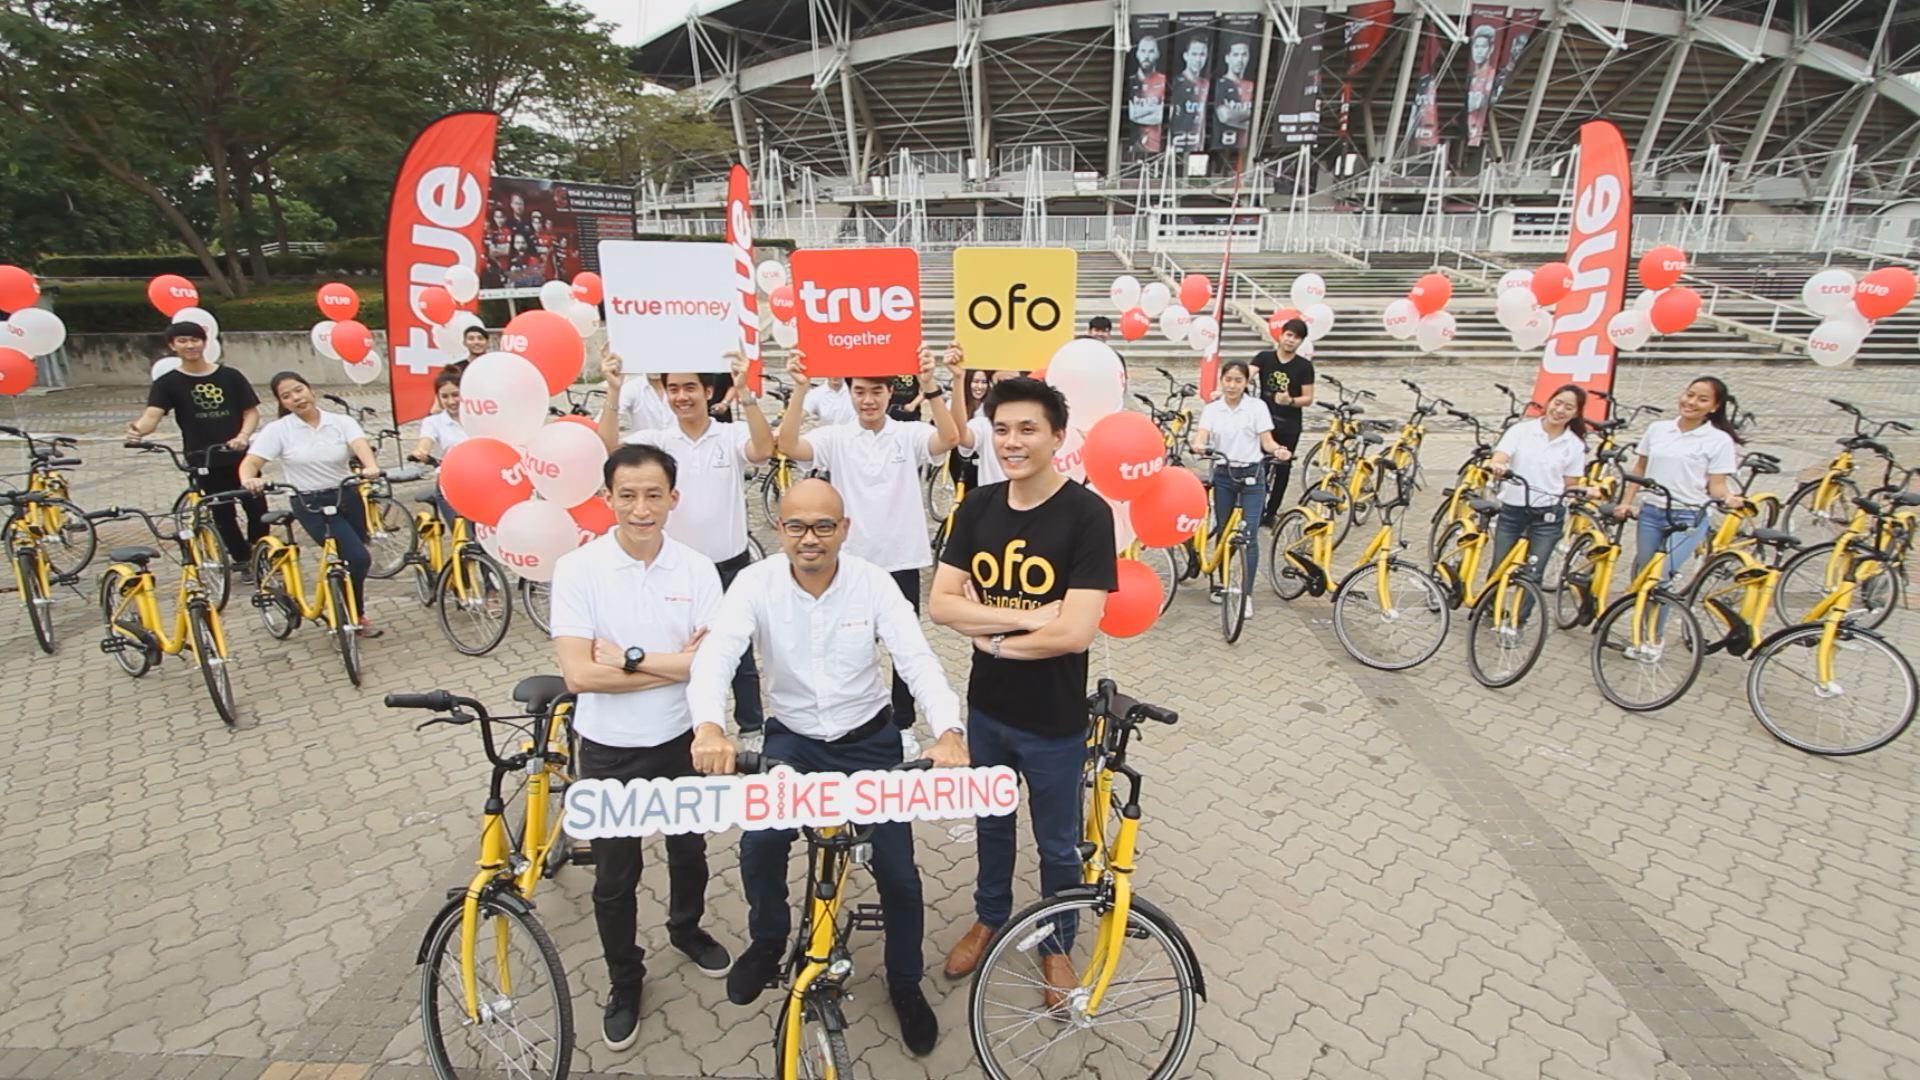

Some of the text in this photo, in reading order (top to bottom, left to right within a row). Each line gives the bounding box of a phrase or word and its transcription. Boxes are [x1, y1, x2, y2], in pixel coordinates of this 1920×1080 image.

[1221, 132, 1237, 145] 8
[1543, 174, 1621, 382] true
[1857, 281, 1890, 297] true
[323, 295, 352, 306] true
[800, 280, 914, 323] true
[968, 283, 1061, 331] ofo
[827, 331, 891, 349] together
[1810, 339, 1839, 352] true
[1119, 456, 1165, 481] true
[971, 539, 1056, 594] ofo
[568, 784, 731, 830] SMART
[855, 772, 1017, 817] SHARING
